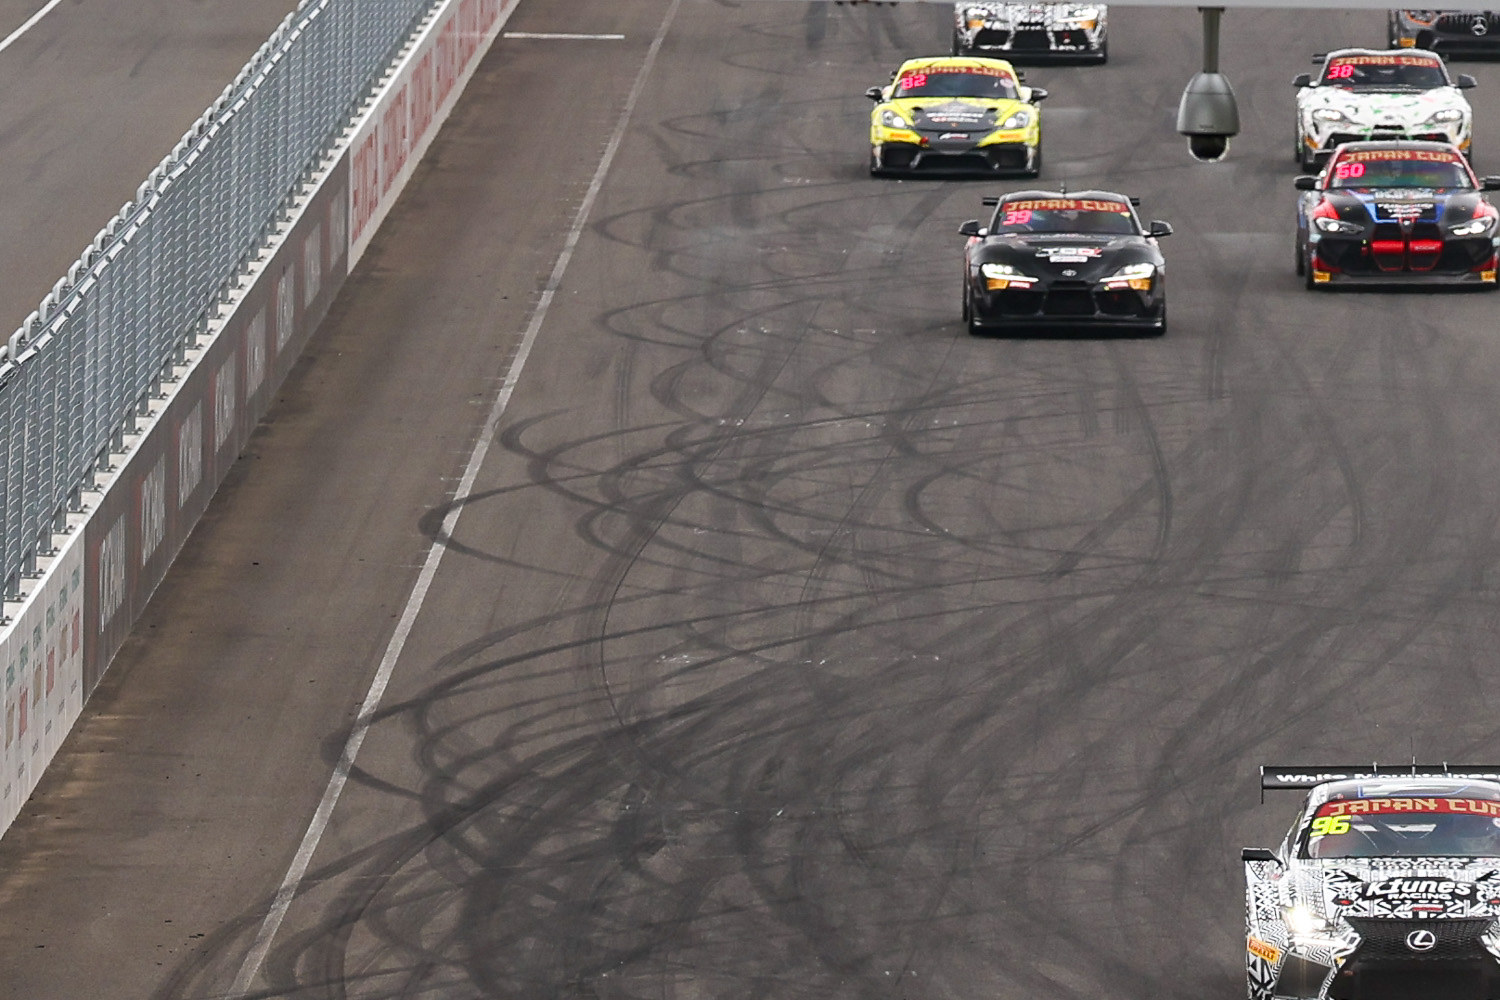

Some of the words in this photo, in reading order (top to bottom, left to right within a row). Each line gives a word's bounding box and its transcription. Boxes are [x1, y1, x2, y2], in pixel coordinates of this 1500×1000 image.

[1327, 65, 1354, 79] 38
[901, 74, 927, 90] 82
[1345, 150, 1411, 162] JAPAN
[1416, 151, 1454, 162] CUP
[1008, 200, 1076, 211] JAPAN
[1082, 200, 1121, 211] CUP
[1002, 210, 1032, 226] 39
[1276, 773, 1347, 782] White
[1329, 798, 1438, 816] JAPAN
[1310, 815, 1352, 837] 96
